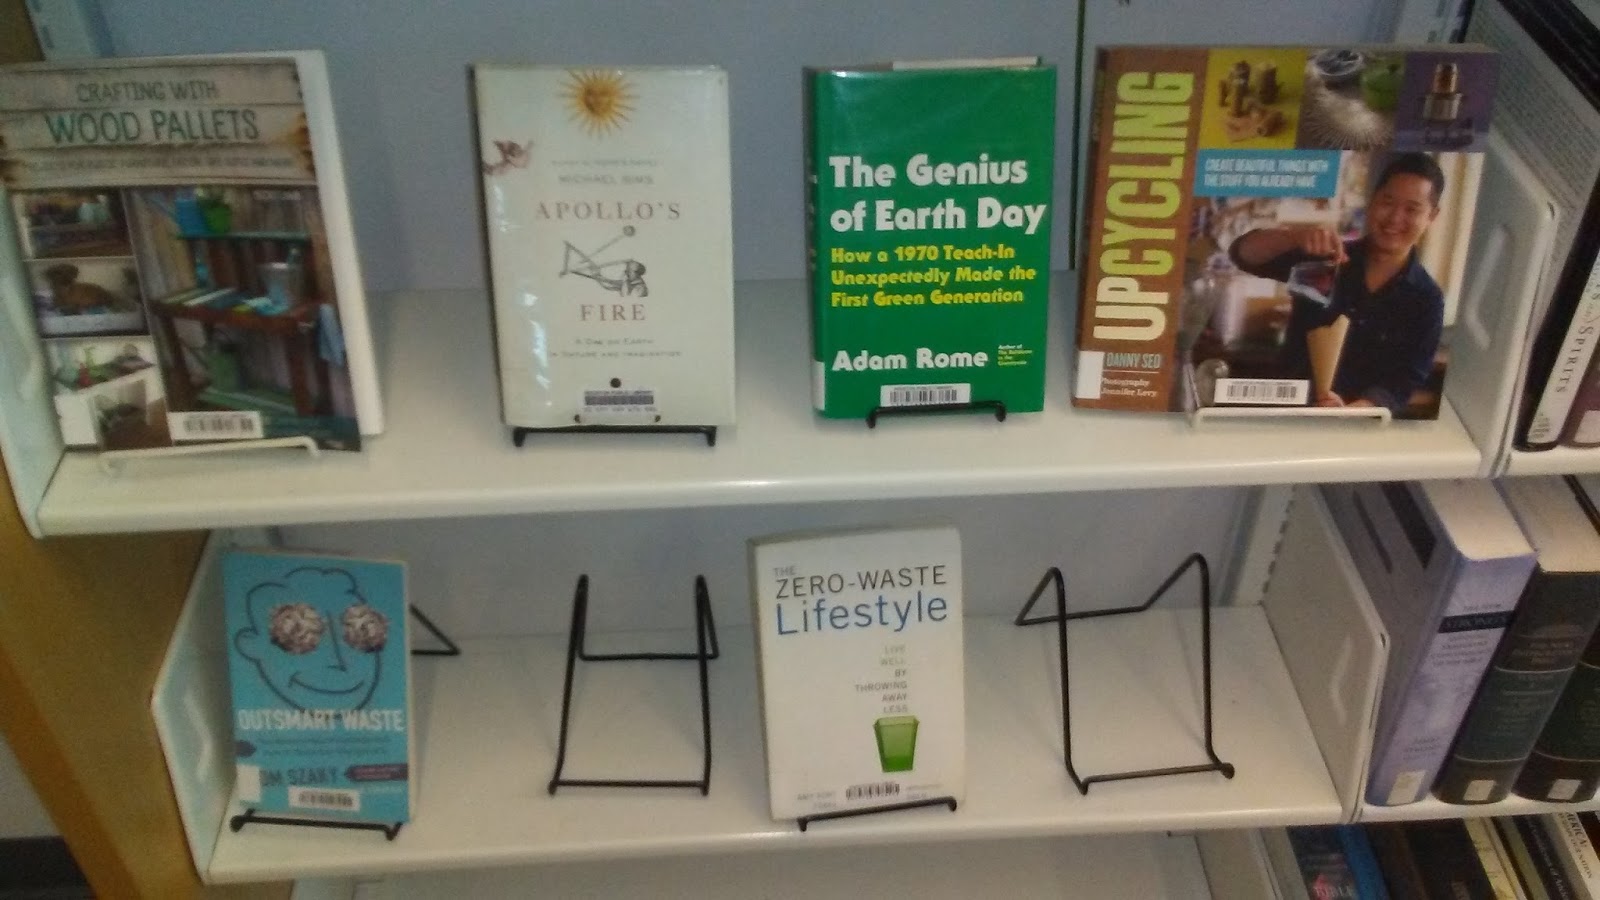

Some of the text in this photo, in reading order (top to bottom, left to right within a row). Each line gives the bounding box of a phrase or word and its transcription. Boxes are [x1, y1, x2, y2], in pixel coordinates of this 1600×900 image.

[76, 80, 219, 101] CRAFTING WITH
[45, 109, 260, 144] WOOD PALLETS
[829, 153, 1028, 188] The Genius
[535, 201, 681, 221] APOLLO'S
[830, 196, 1048, 235] of Earth Day
[1092, 71, 1195, 341] UPCYCLING
[831, 244, 1016, 264] How a 1970 Teach-In
[831, 265, 1037, 288] Unexpectedly Made the
[831, 288, 1024, 307] First Green Generation
[580, 303, 648, 322] FIRE
[831, 347, 989, 372] Adam Rome
[776, 565, 947, 599] ZERO-WASTE
[776, 590, 948, 636] Lifestyle
[895, 668, 907, 678] BY
[855, 681, 908, 692] THROWING
[882, 692, 908, 703] AWAY
[237, 709, 406, 731] OUTSMART WASTE
